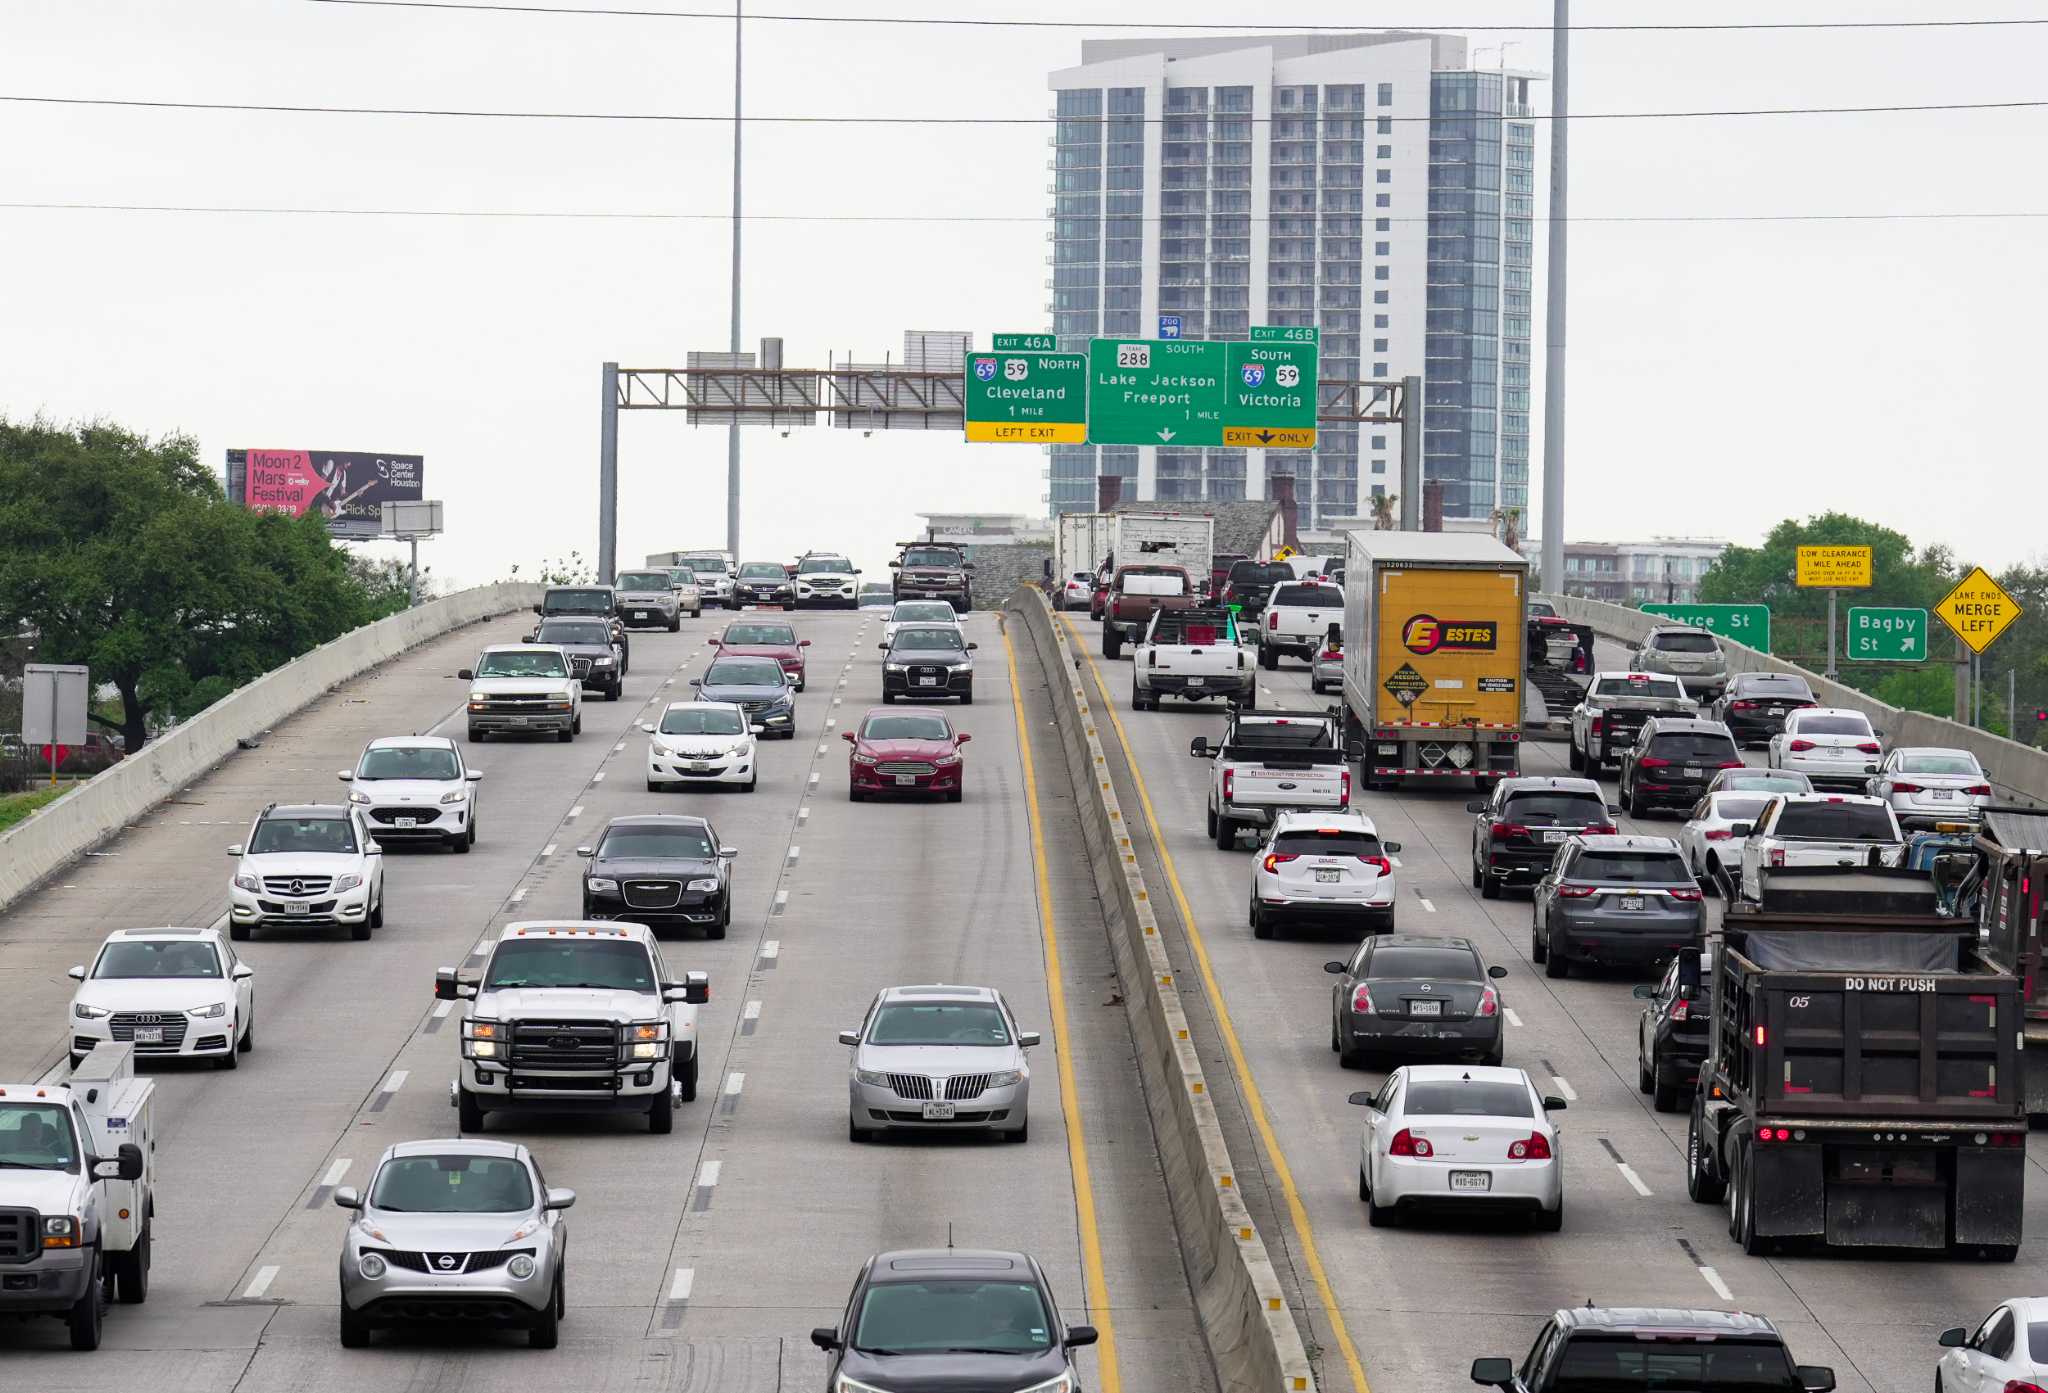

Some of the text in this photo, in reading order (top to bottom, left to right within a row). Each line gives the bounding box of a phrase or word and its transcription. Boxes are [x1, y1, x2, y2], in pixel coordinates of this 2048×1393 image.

[1254, 329, 1314, 340] EXIT 46B
[997, 337, 1051, 348] EXIT 46A
[1166, 344, 1205, 354] SOUTH
[1119, 352, 1148, 365] 288
[1250, 348, 1291, 361] SOUTH
[976, 363, 995, 377] 69
[1007, 363, 1026, 376] 59
[1038, 358, 1080, 370] NORTH
[1100, 373, 1216, 387] Lake Jackson
[1244, 370, 1262, 382] 69
[1278, 369, 1297, 382] 59
[986, 386, 1066, 400] Cleveland
[1123, 391, 1191, 406] Freeport
[1239, 393, 1302, 407] Victoria
[1008, 405, 1044, 417] 1 MILE
[1184, 409, 1220, 421] 1 MILE
[995, 428, 1056, 438] LEFT EXIT
[1226, 432, 1310, 443] EXIT ONLY
[253, 453, 301, 470] Moon 2
[391, 460, 414, 470] Space
[253, 469, 286, 486] Mars
[390, 469, 415, 479] Center
[390, 478, 420, 488] Houston
[253, 486, 304, 503] Festival
[345, 503, 382, 518] Rick Sp
[1801, 550, 1867, 558] LOW CLEARANCE
[1814, 560, 1831, 568] MILE
[1836, 560, 1862, 568] AHEAD
[1954, 591, 2002, 600] LANE ENDS
[1955, 603, 2001, 616] MERGE
[1730, 613, 1750, 627] St
[1859, 615, 1916, 633] Bagby
[1961, 619, 1995, 632] LEFT
[1406, 622, 1492, 646] E ESTES
[1859, 637, 1878, 651] St
[1845, 977, 1936, 992] DO NOT PUSH
[1790, 996, 1811, 1008] 05
